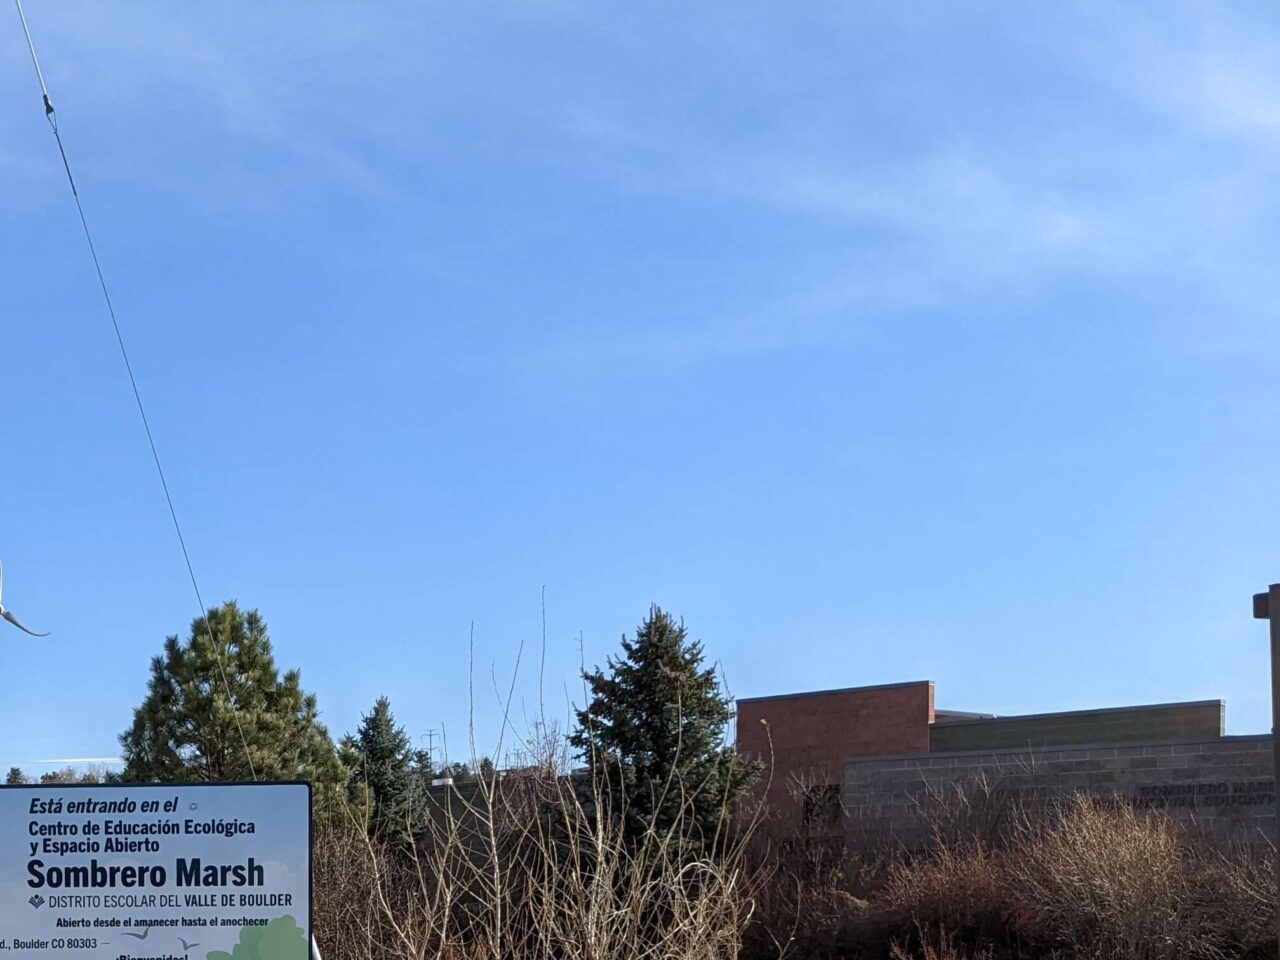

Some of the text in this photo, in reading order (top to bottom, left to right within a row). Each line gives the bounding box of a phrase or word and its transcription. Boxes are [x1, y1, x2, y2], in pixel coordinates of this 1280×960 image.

[29, 797, 178, 814] Está entrando en el
[29, 819, 255, 837] Centro de Educación Ecológica
[30, 837, 159, 856] y Espacio Abierto
[28, 858, 264, 888] Sombrero Marsh
[49, 894, 292, 908] DISTRITO ESCOLAR DEL VALLE DE BOULDER
[56, 916, 268, 928] Abierto desde el amanecer hasta el anochecer
[14, 939, 49, 949] Boulder
[51, 939, 64, 949] CO
[67, 938, 97, 949] 80303
